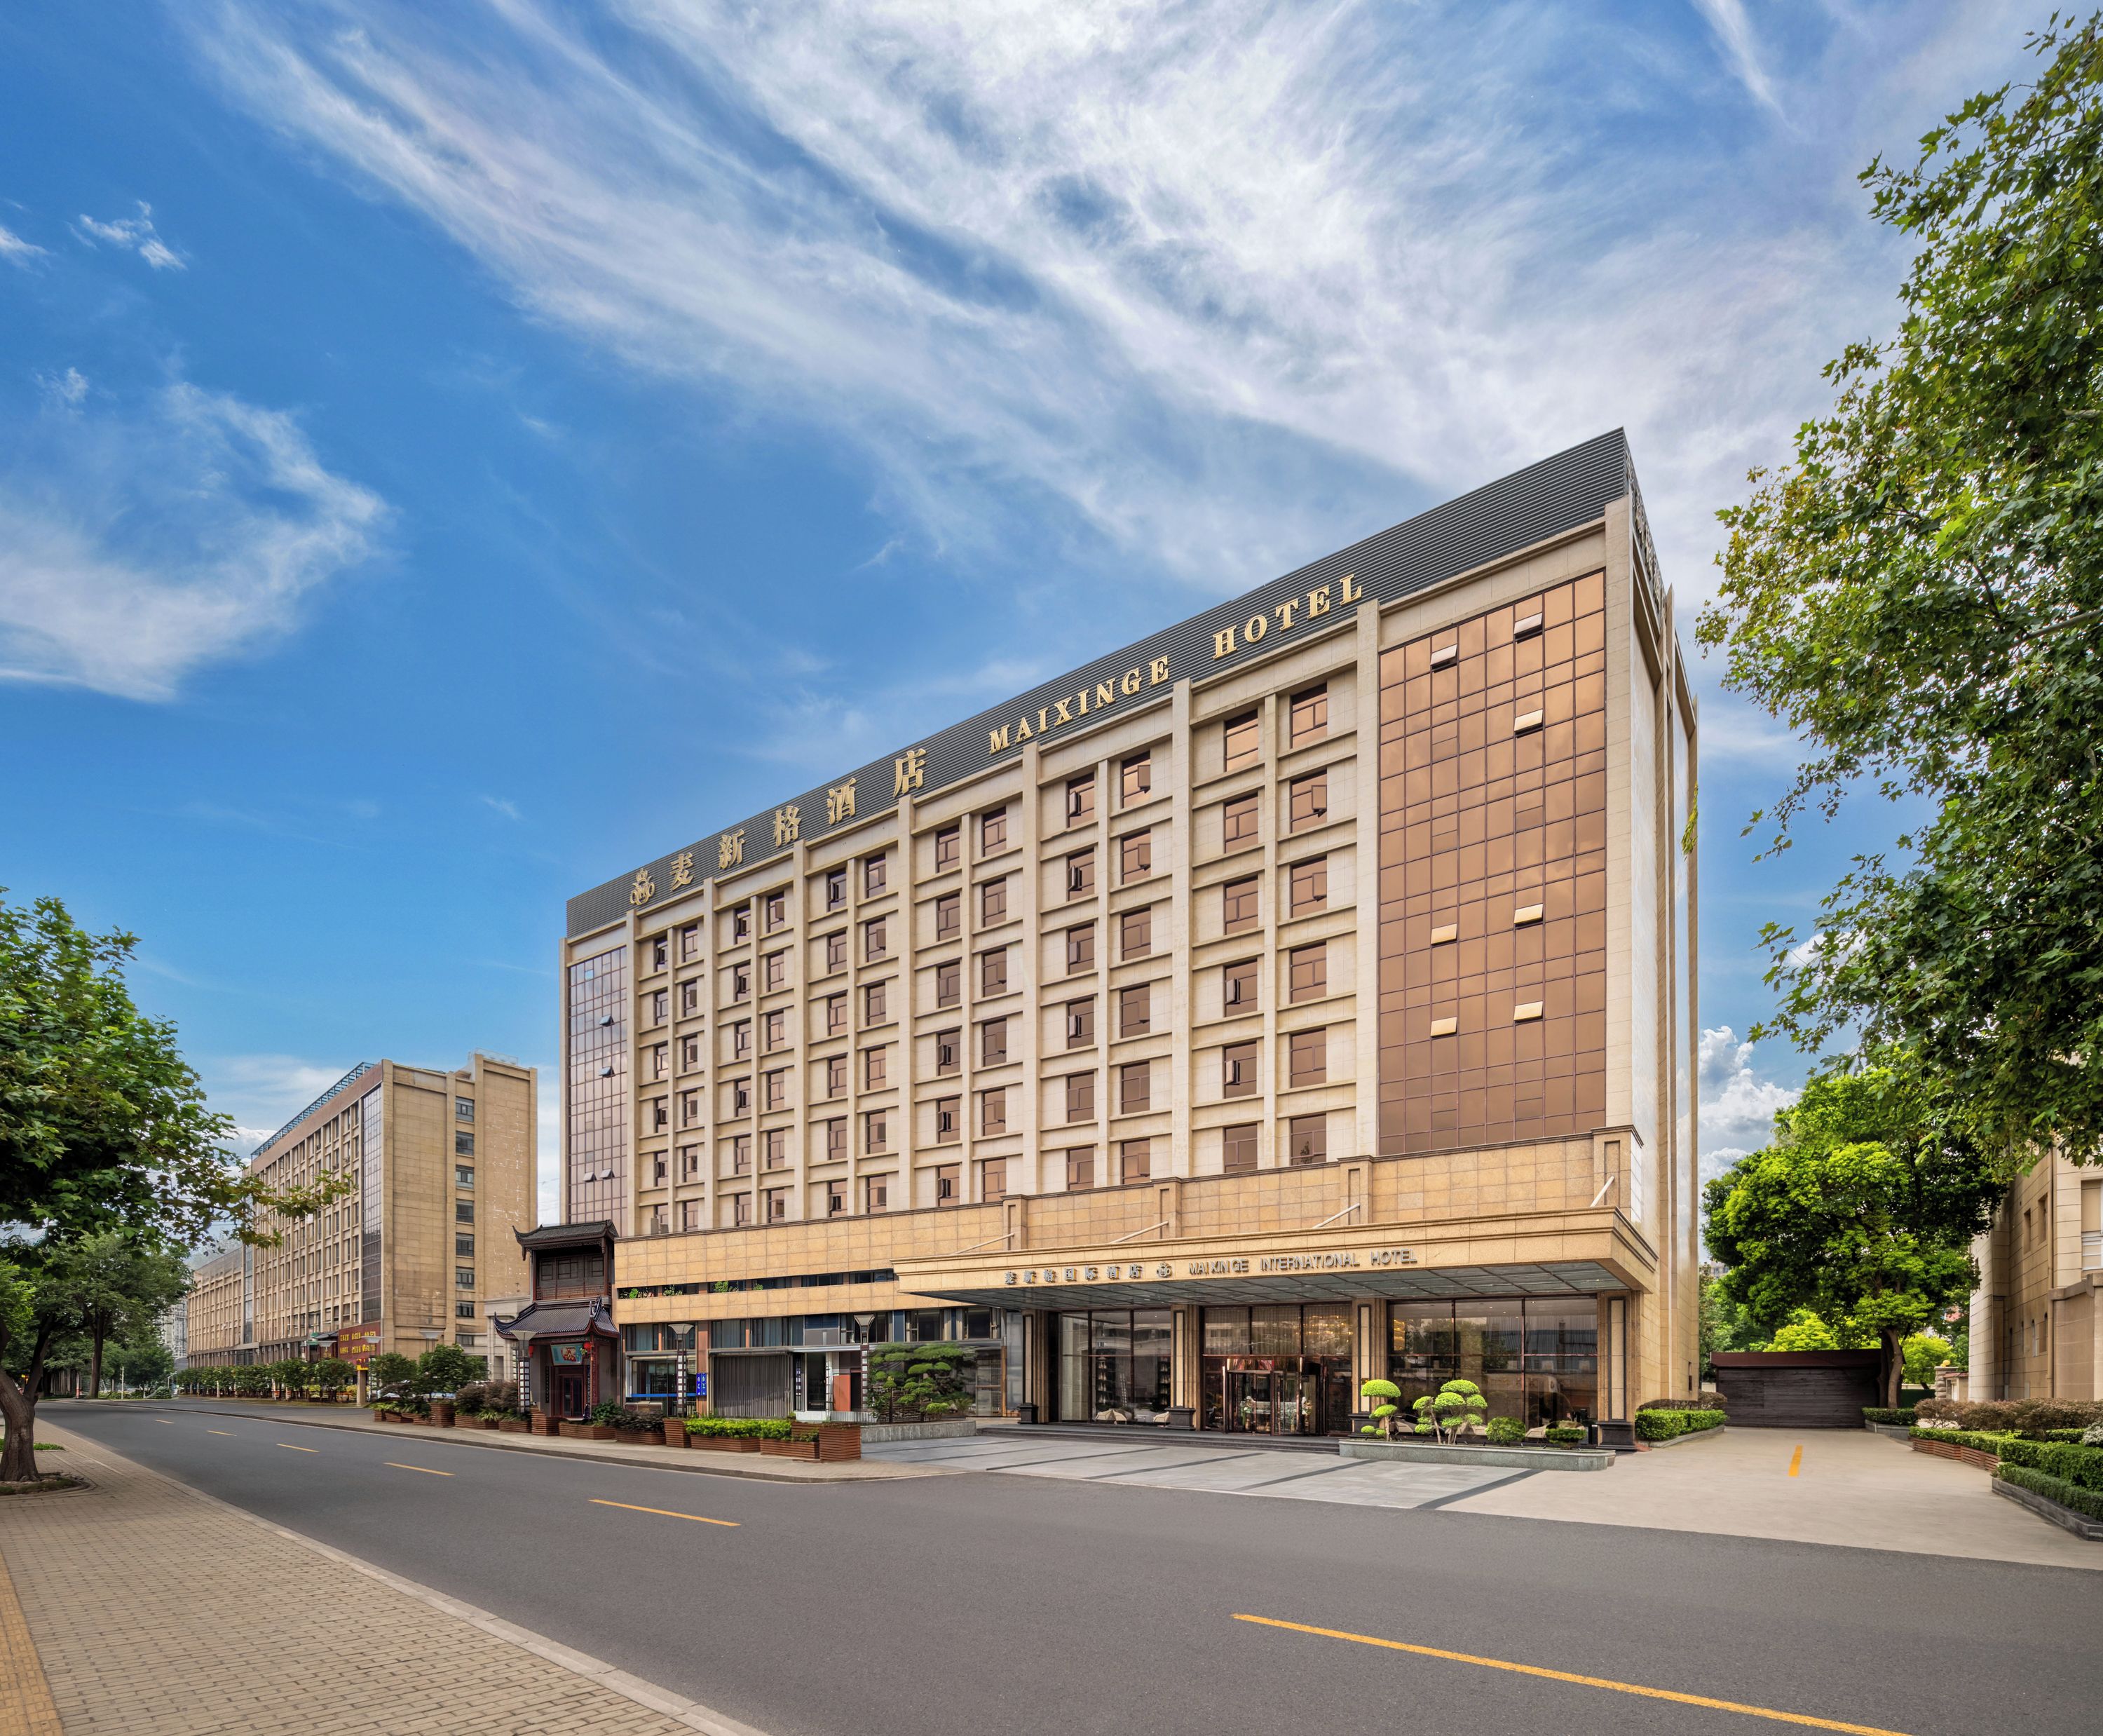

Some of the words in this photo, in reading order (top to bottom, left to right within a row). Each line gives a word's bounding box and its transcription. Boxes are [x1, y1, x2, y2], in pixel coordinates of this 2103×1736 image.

[989, 656, 1169, 754] MAIXINGE
[1213, 574, 1362, 659] HOTEL
[669, 748, 927, 890] 麦新格酒店
[1189, 1259, 1249, 1275] MAIXINGE
[1260, 1253, 1360, 1271] INTERNATIONAL
[1370, 1249, 1417, 1265] HOTEL
